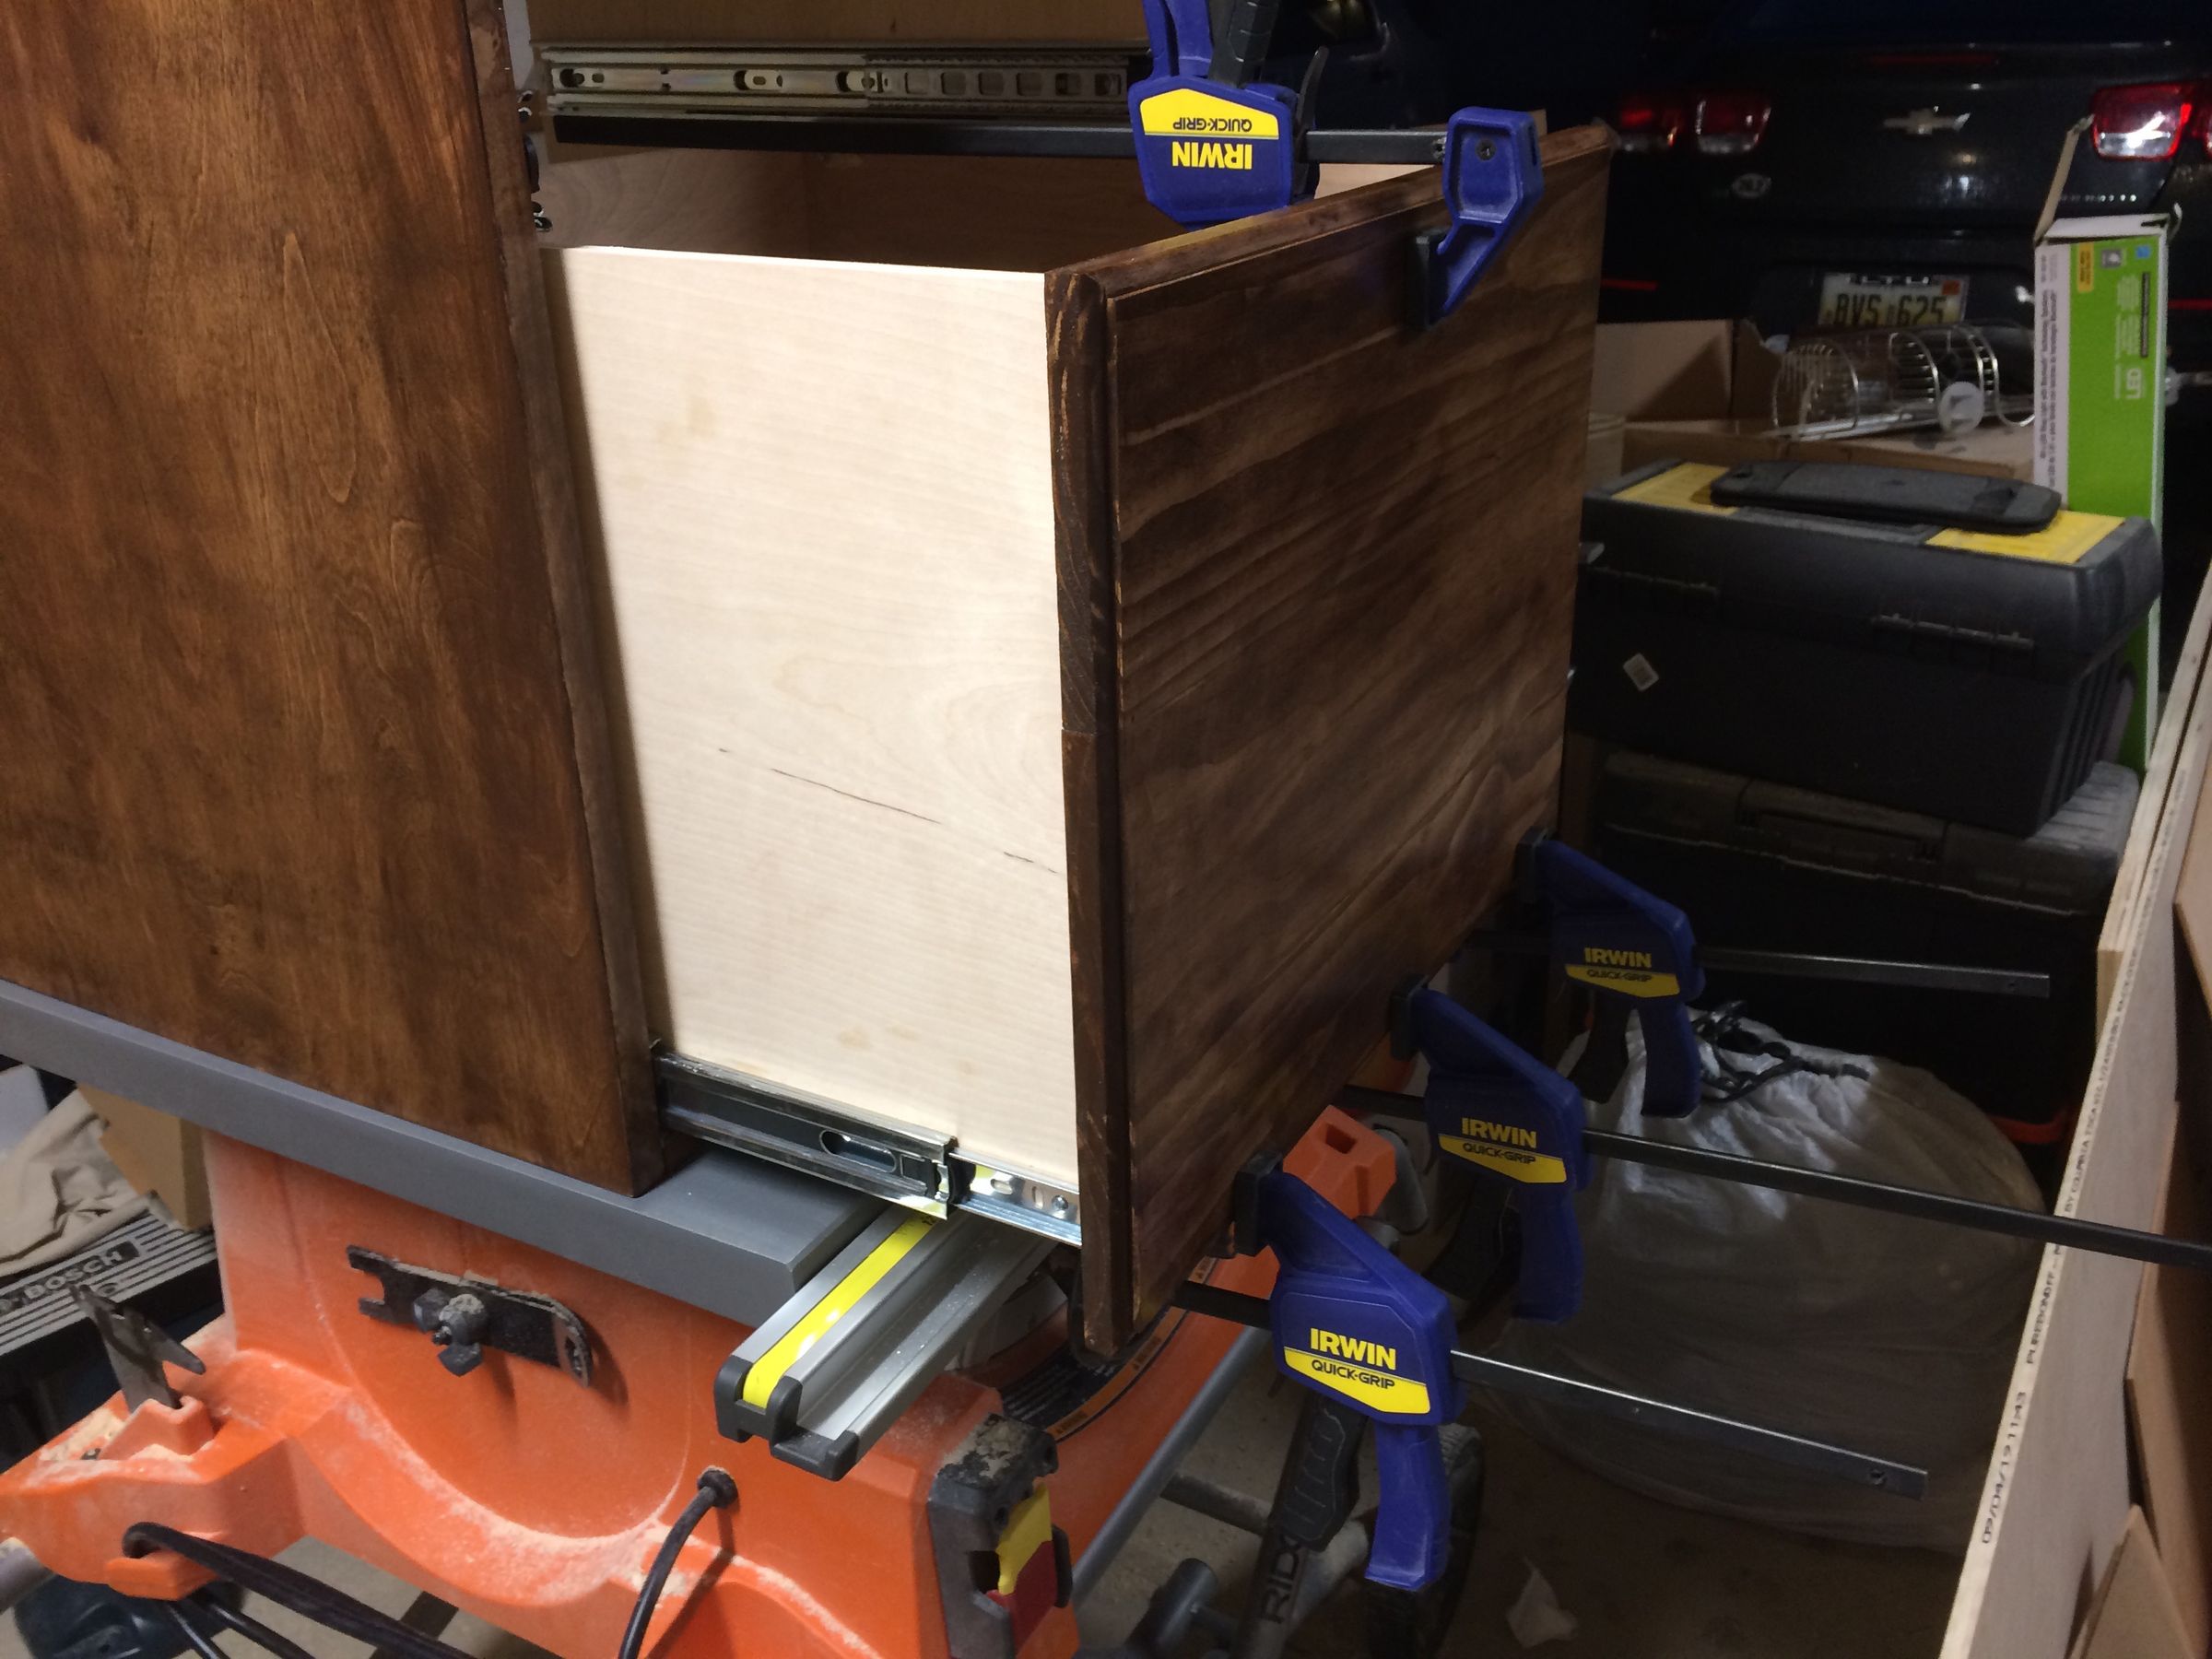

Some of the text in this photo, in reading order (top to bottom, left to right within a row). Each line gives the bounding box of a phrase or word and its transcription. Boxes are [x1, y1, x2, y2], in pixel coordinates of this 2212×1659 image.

[1172, 141, 1253, 170] IRWIN
[1584, 947, 1652, 969] IRWIN
[1586, 969, 1652, 982] QUICK-GRIP
[1462, 1117, 1536, 1148] IRWIN
[1463, 1142, 1536, 1164] QUICK-GRIP
[24, 1251, 123, 1300] BOSCH
[1311, 1327, 1396, 1371] IRWIN
[1312, 1359, 1395, 1389] QUICK-GRIP
